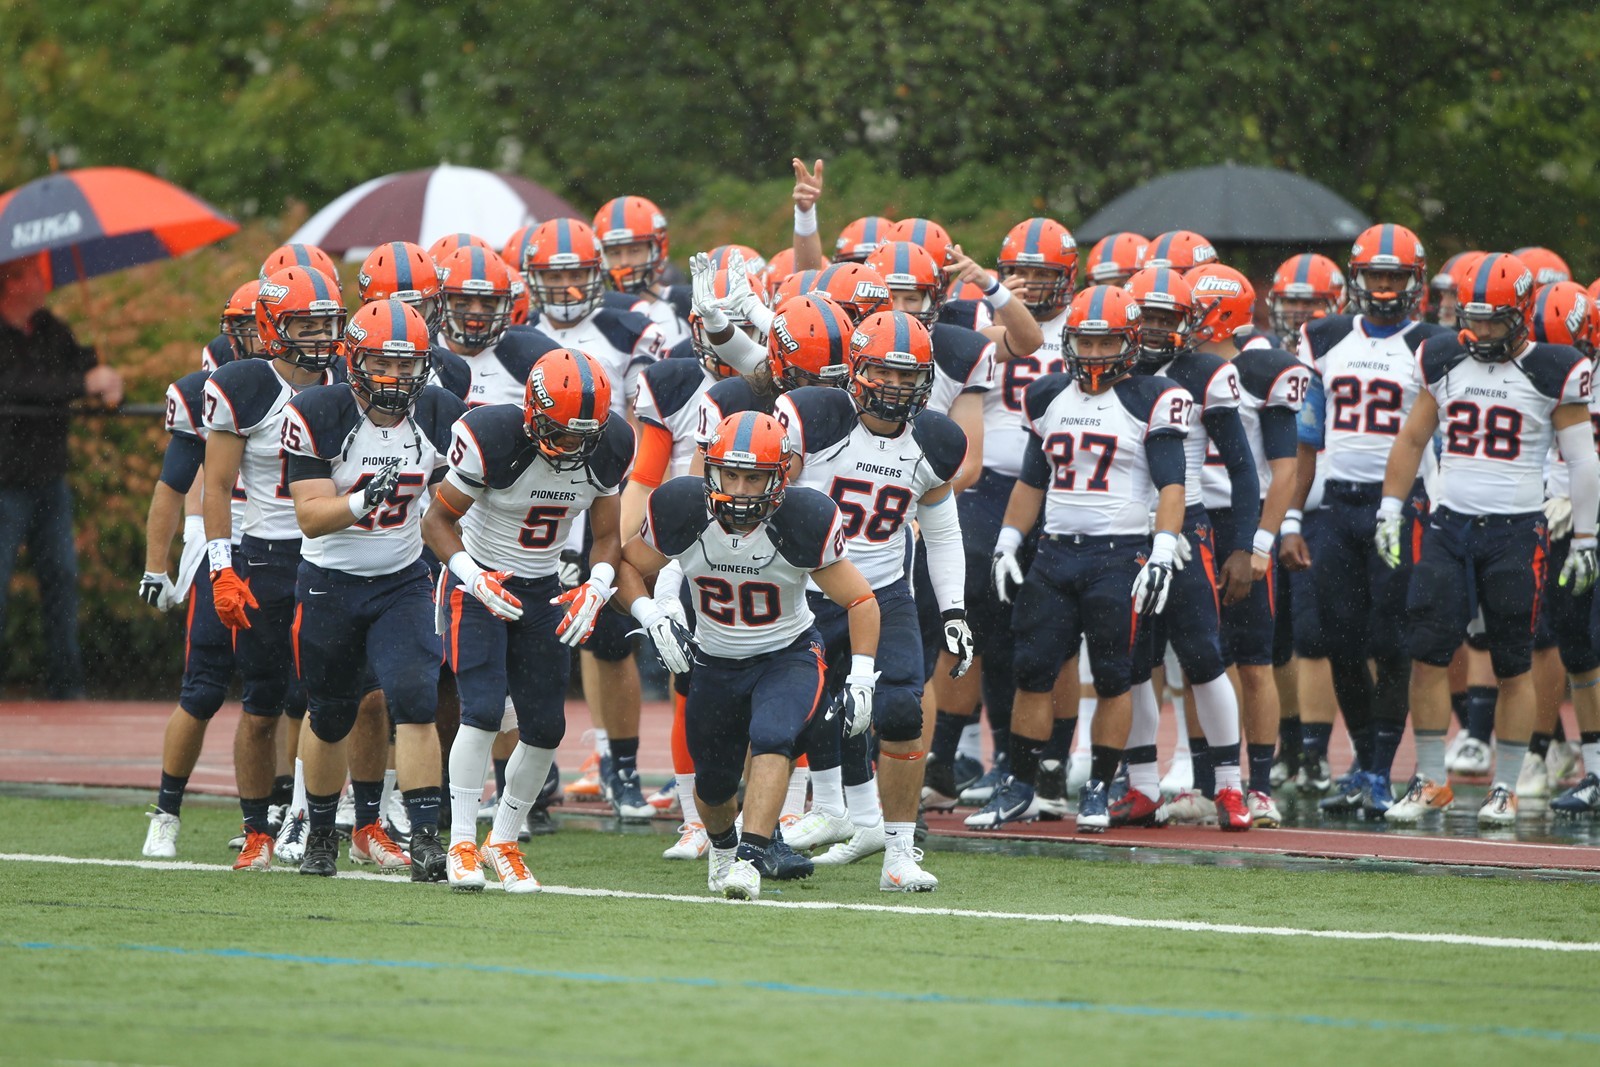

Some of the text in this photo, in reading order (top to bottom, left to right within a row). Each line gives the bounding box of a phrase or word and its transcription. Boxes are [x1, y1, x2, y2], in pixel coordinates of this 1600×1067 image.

[857, 282, 890, 298] UTICA
[1197, 277, 1240, 291] UTICA
[773, 314, 799, 352] UTICA
[1347, 361, 1391, 373] PIONEERS
[532, 367, 555, 408] UTICA
[1227, 374, 1240, 400] 8
[1287, 375, 1309, 402] 38
[1464, 386, 1508, 400] PIONEERS
[1169, 397, 1193, 426] 27
[1330, 375, 1403, 435] 22
[281, 416, 302, 452] 45
[1060, 416, 1102, 427] PIONEERS
[1447, 400, 1522, 461] 28
[450, 435, 468, 466] 5
[1043, 431, 1118, 492] 27
[856, 461, 903, 479] PIONEERS
[530, 490, 577, 502] PIONEERS
[829, 474, 913, 544] 58
[518, 505, 569, 549] 5
[710, 563, 761, 576] PIONEERS
[693, 575, 782, 627] 20
